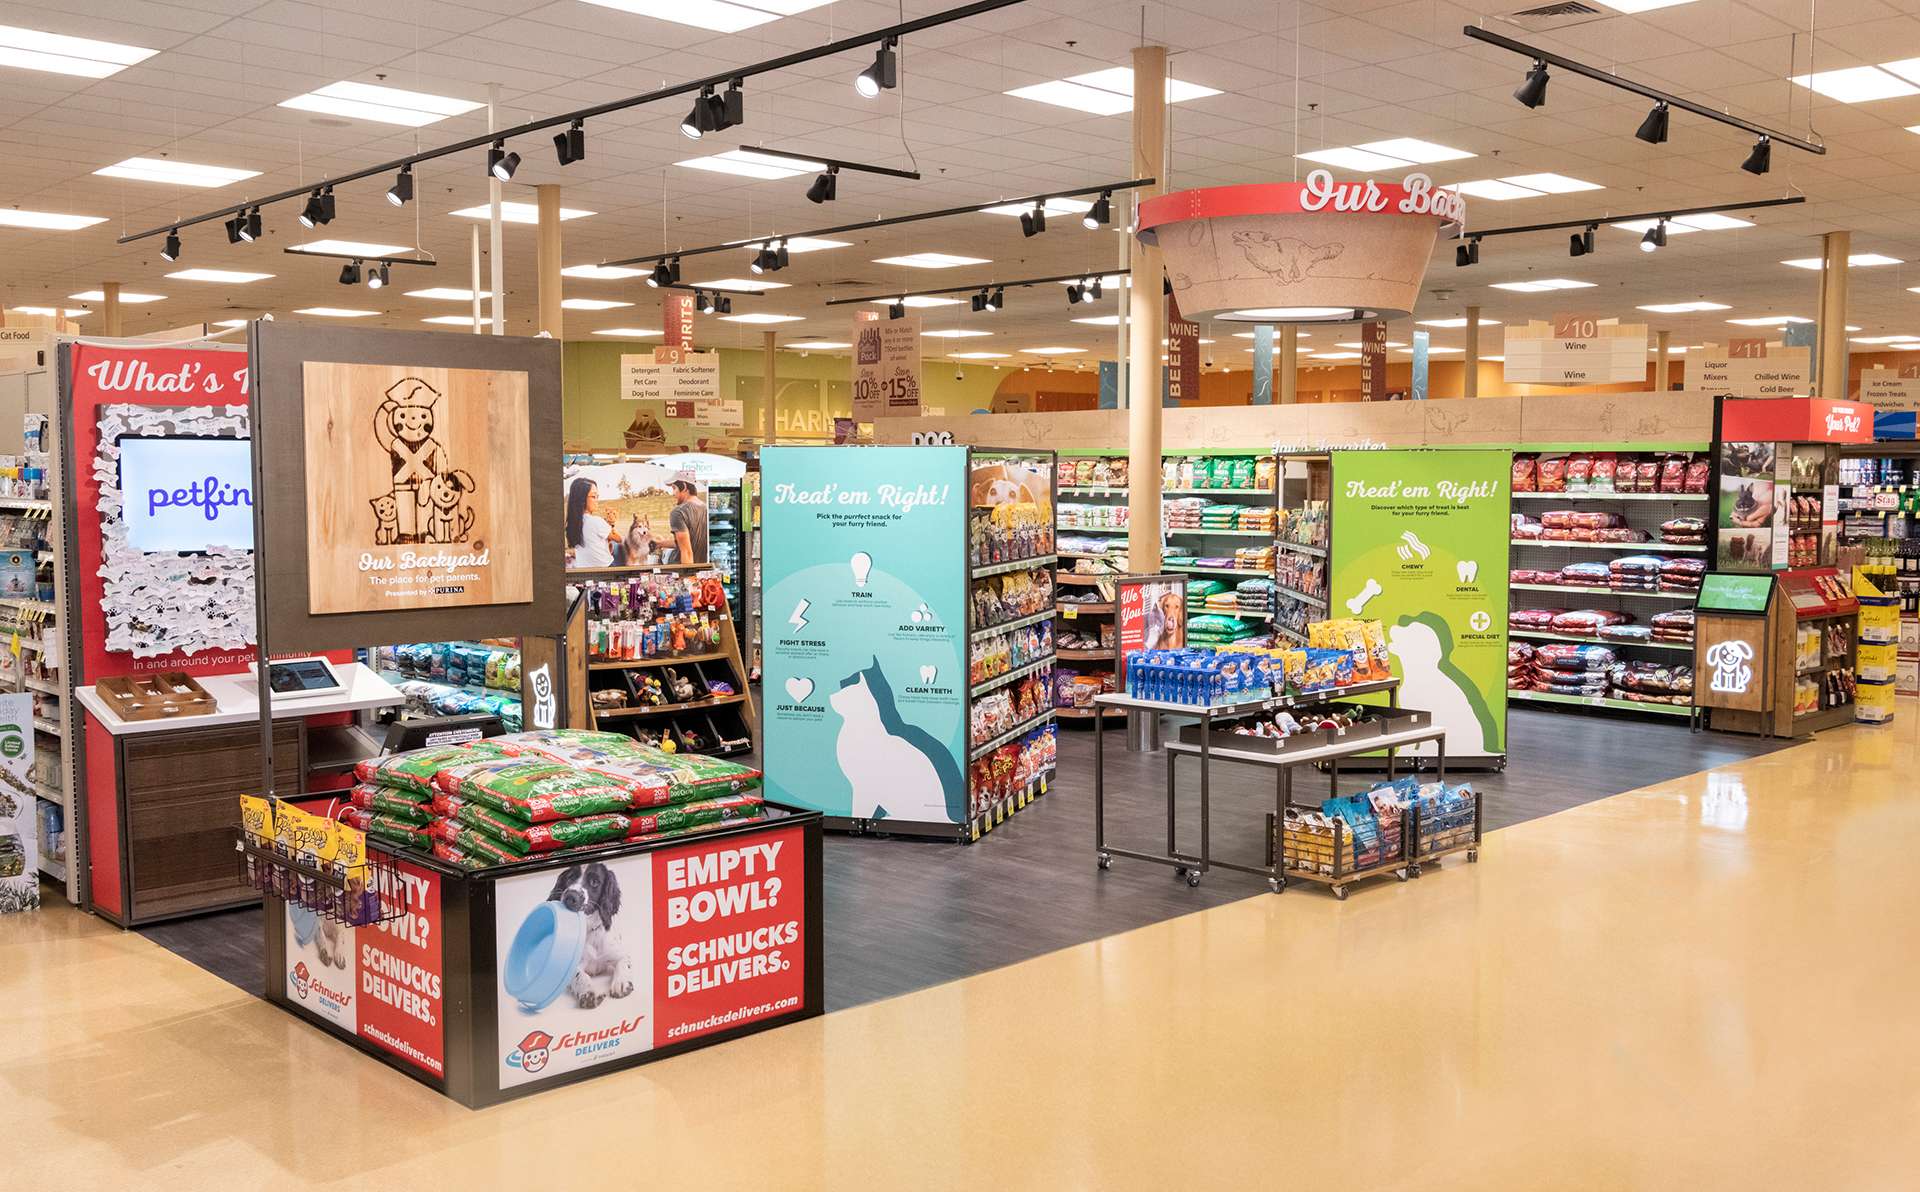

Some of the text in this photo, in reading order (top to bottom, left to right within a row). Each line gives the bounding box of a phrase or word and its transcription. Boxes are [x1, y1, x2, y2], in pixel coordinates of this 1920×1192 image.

[1300, 169, 1388, 211] Our
[0, 331, 30, 340] Cat Food
[1170, 323, 1198, 336] WINE
[1572, 320, 1594, 338] 10
[1363, 341, 1386, 354] WINE
[1565, 342, 1587, 350] Wine
[1744, 343, 1761, 358] 11
[669, 349, 679, 364] 9
[1704, 361, 1728, 369] Liquor
[631, 367, 660, 375] Detergent
[691, 366, 716, 374] Softener
[860, 368, 874, 378] Save
[895, 366, 910, 376] Save
[1169, 338, 1181, 397] BEER
[1564, 370, 1586, 379] Wine
[88, 360, 224, 393] What's
[870, 390, 880, 399] OFF
[907, 388, 919, 397] OFF
[1759, 385, 1795, 393] Cold Beer
[1825, 413, 1861, 436] Your Pet?
[681, 461, 713, 472] Freshpet
[877, 484, 950, 513] Right!
[1436, 480, 1498, 504] Right!
[1876, 495, 1896, 506] Stag
[848, 520, 865, 528] furry
[358, 548, 490, 574] Our Backyard
[370, 573, 481, 586] The place for pet parents.
[385, 586, 464, 597] Presented by PURINA
[1121, 587, 1139, 604] We
[1121, 604, 1145, 626] You!
[133, 661, 144, 670] In
[146, 659, 168, 669] and
[170, 656, 209, 667] around
[211, 655, 235, 667] your
[237, 653, 255, 665] pet
[667, 841, 784, 891] EMPTY
[368, 858, 430, 910] MPTY
[667, 877, 782, 928] BOWL?
[377, 899, 430, 949] OWL?
[667, 921, 799, 971] SCHNUCKS
[362, 944, 442, 1000] SCHNUCKS
[319, 996, 341, 1013] DELIVERS
[667, 995, 799, 1039] schnucksdelivers.com
[363, 1022, 442, 1072] schnucksdelivers.com
[575, 1038, 620, 1057] DELIVERS
